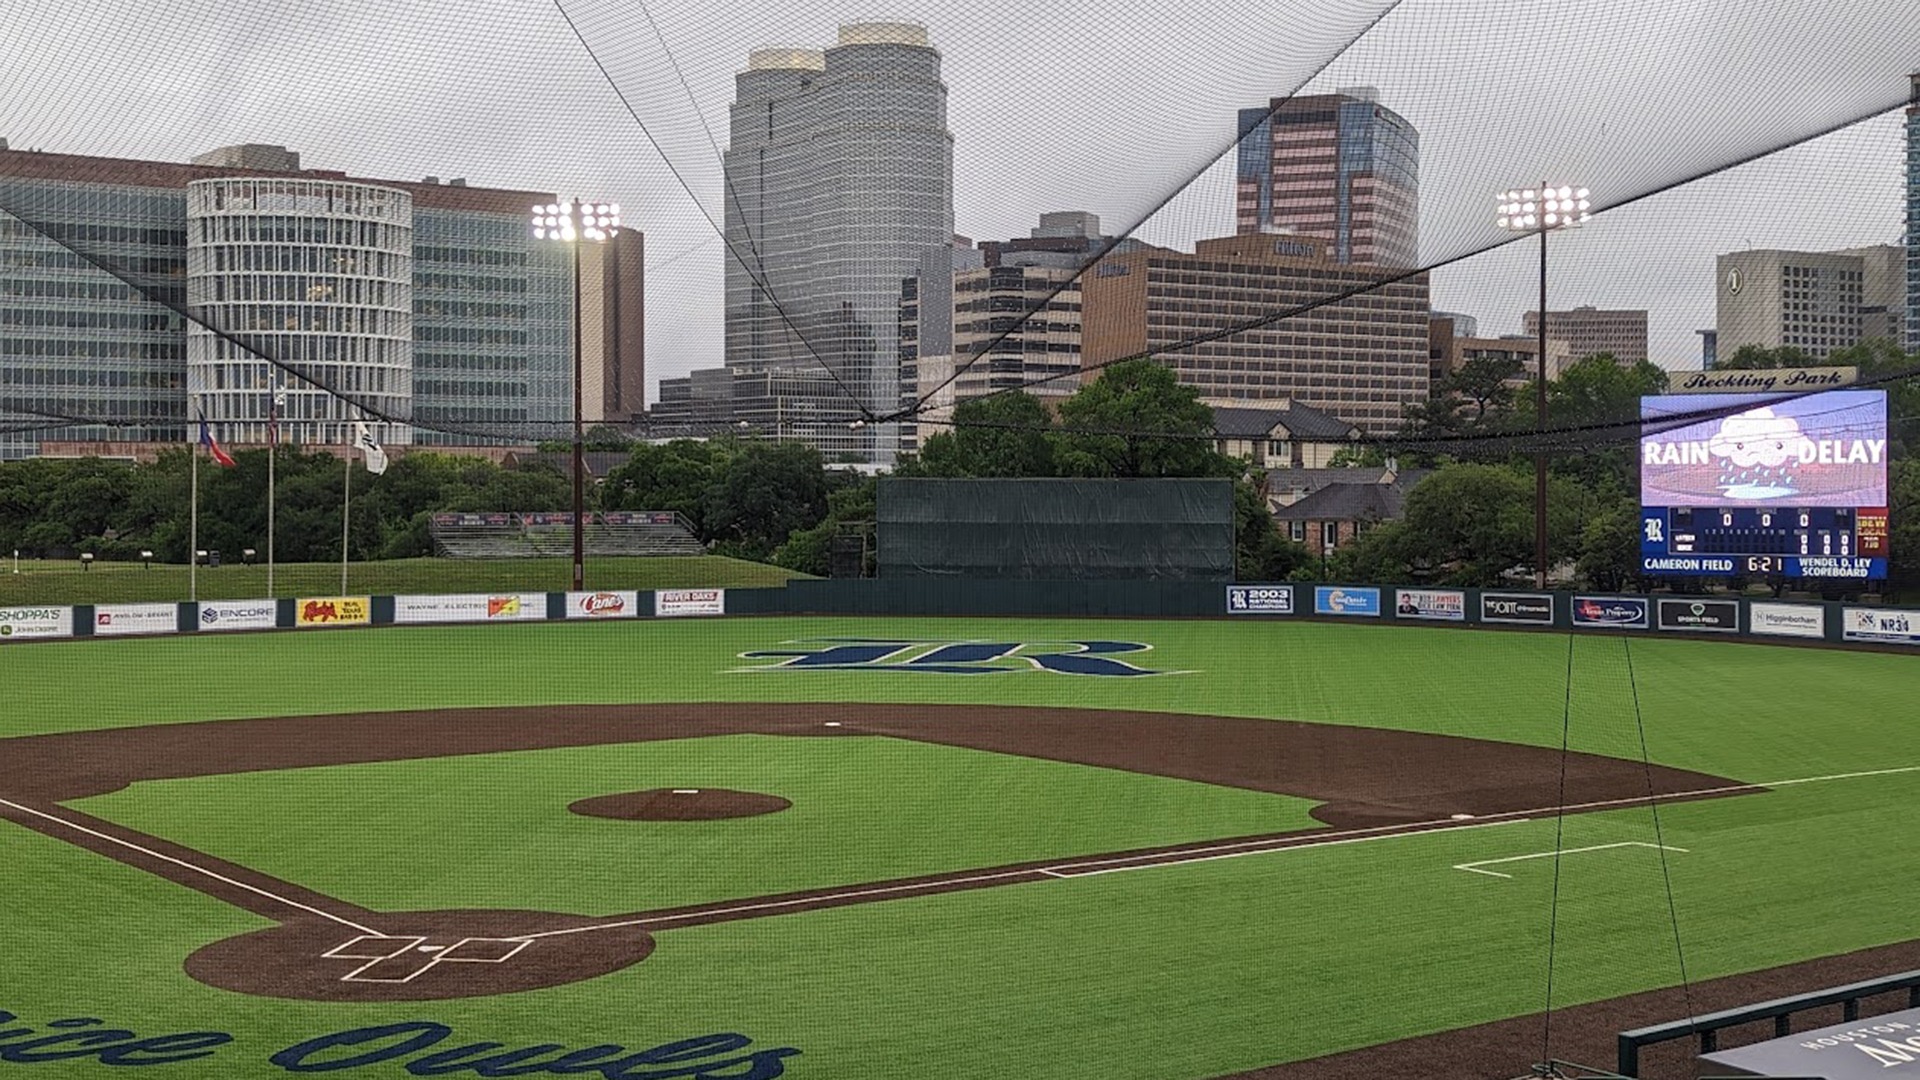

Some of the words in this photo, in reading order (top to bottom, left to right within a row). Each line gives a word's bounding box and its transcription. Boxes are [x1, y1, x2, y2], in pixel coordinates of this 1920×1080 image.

[1683, 373, 1777, 391] Reckling
[1784, 370, 1842, 386] Park
[1644, 441, 1709, 465] RAIN
[1797, 440, 1886, 465] DELAY
[1723, 514, 1732, 526] 0
[1762, 514, 1771, 527] 0
[1644, 558, 1701, 570] CAMERON
[1702, 559, 1733, 571] FIELD
[1799, 557, 1841, 567] WENDEL
[1855, 558, 1872, 568] LEY
[1801, 567, 1868, 578] SCOREBOARD
[1248, 590, 1289, 598] 2003
[0, 609, 60, 622] SHOPPA'S
[219, 608, 274, 617] ENCORE
[1766, 614, 1818, 625] Higginbotham
[0, 1010, 234, 1066] ice
[1799, 1021, 1912, 1051] HOUSTON
